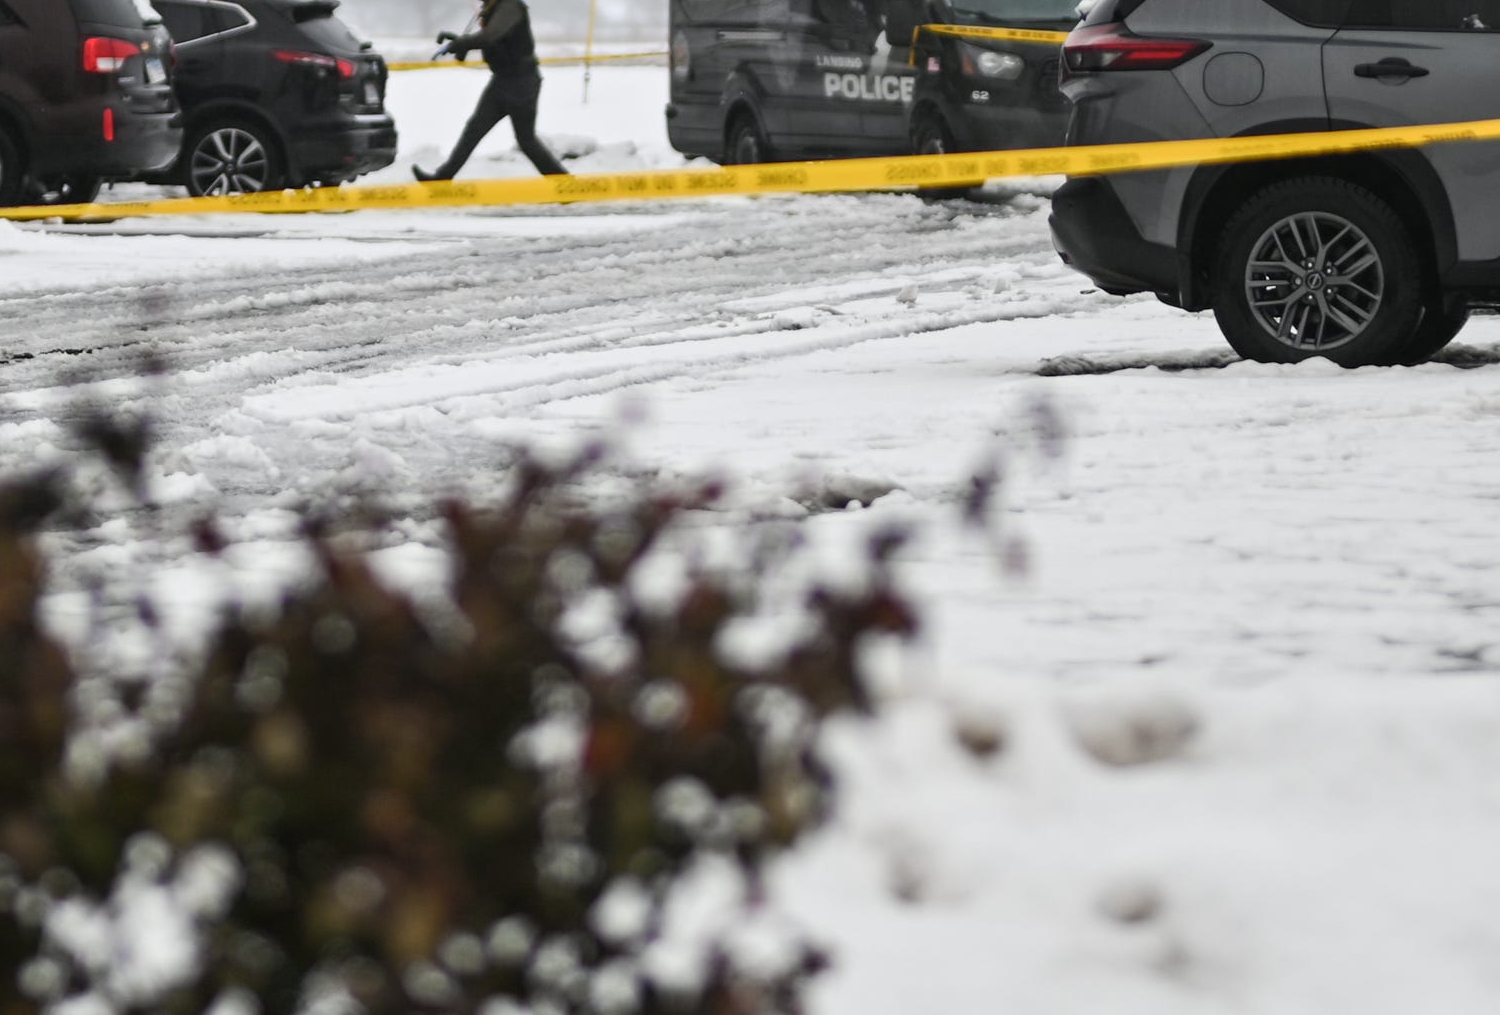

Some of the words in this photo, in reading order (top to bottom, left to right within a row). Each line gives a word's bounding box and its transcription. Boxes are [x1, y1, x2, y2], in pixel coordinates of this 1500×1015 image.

[816, 54, 863, 68] LANSING
[823, 72, 915, 102] POLICE
[971, 90, 989, 100] 62
